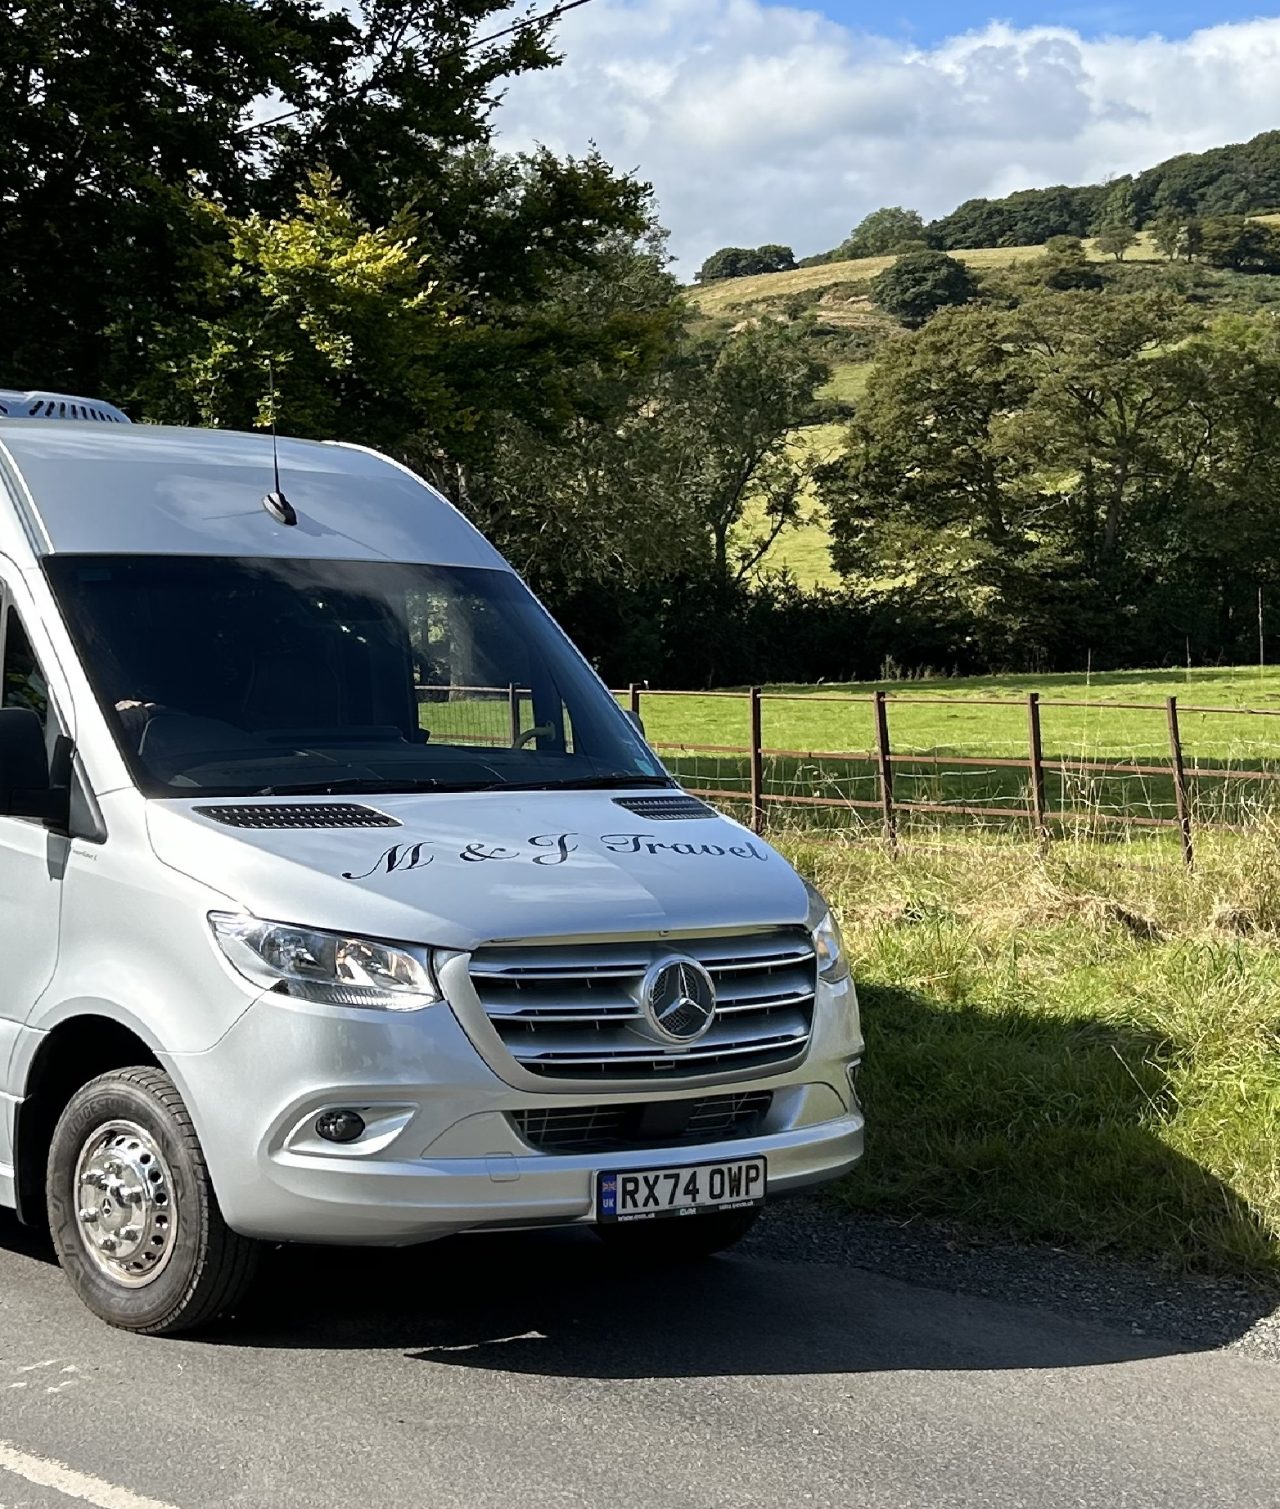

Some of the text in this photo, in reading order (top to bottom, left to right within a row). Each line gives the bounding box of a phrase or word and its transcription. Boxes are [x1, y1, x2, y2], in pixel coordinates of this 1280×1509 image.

[341, 832, 769, 880] M & J Travel
[602, 1197, 615, 1208] UK
[621, 1164, 760, 1209] RX74 OWP
